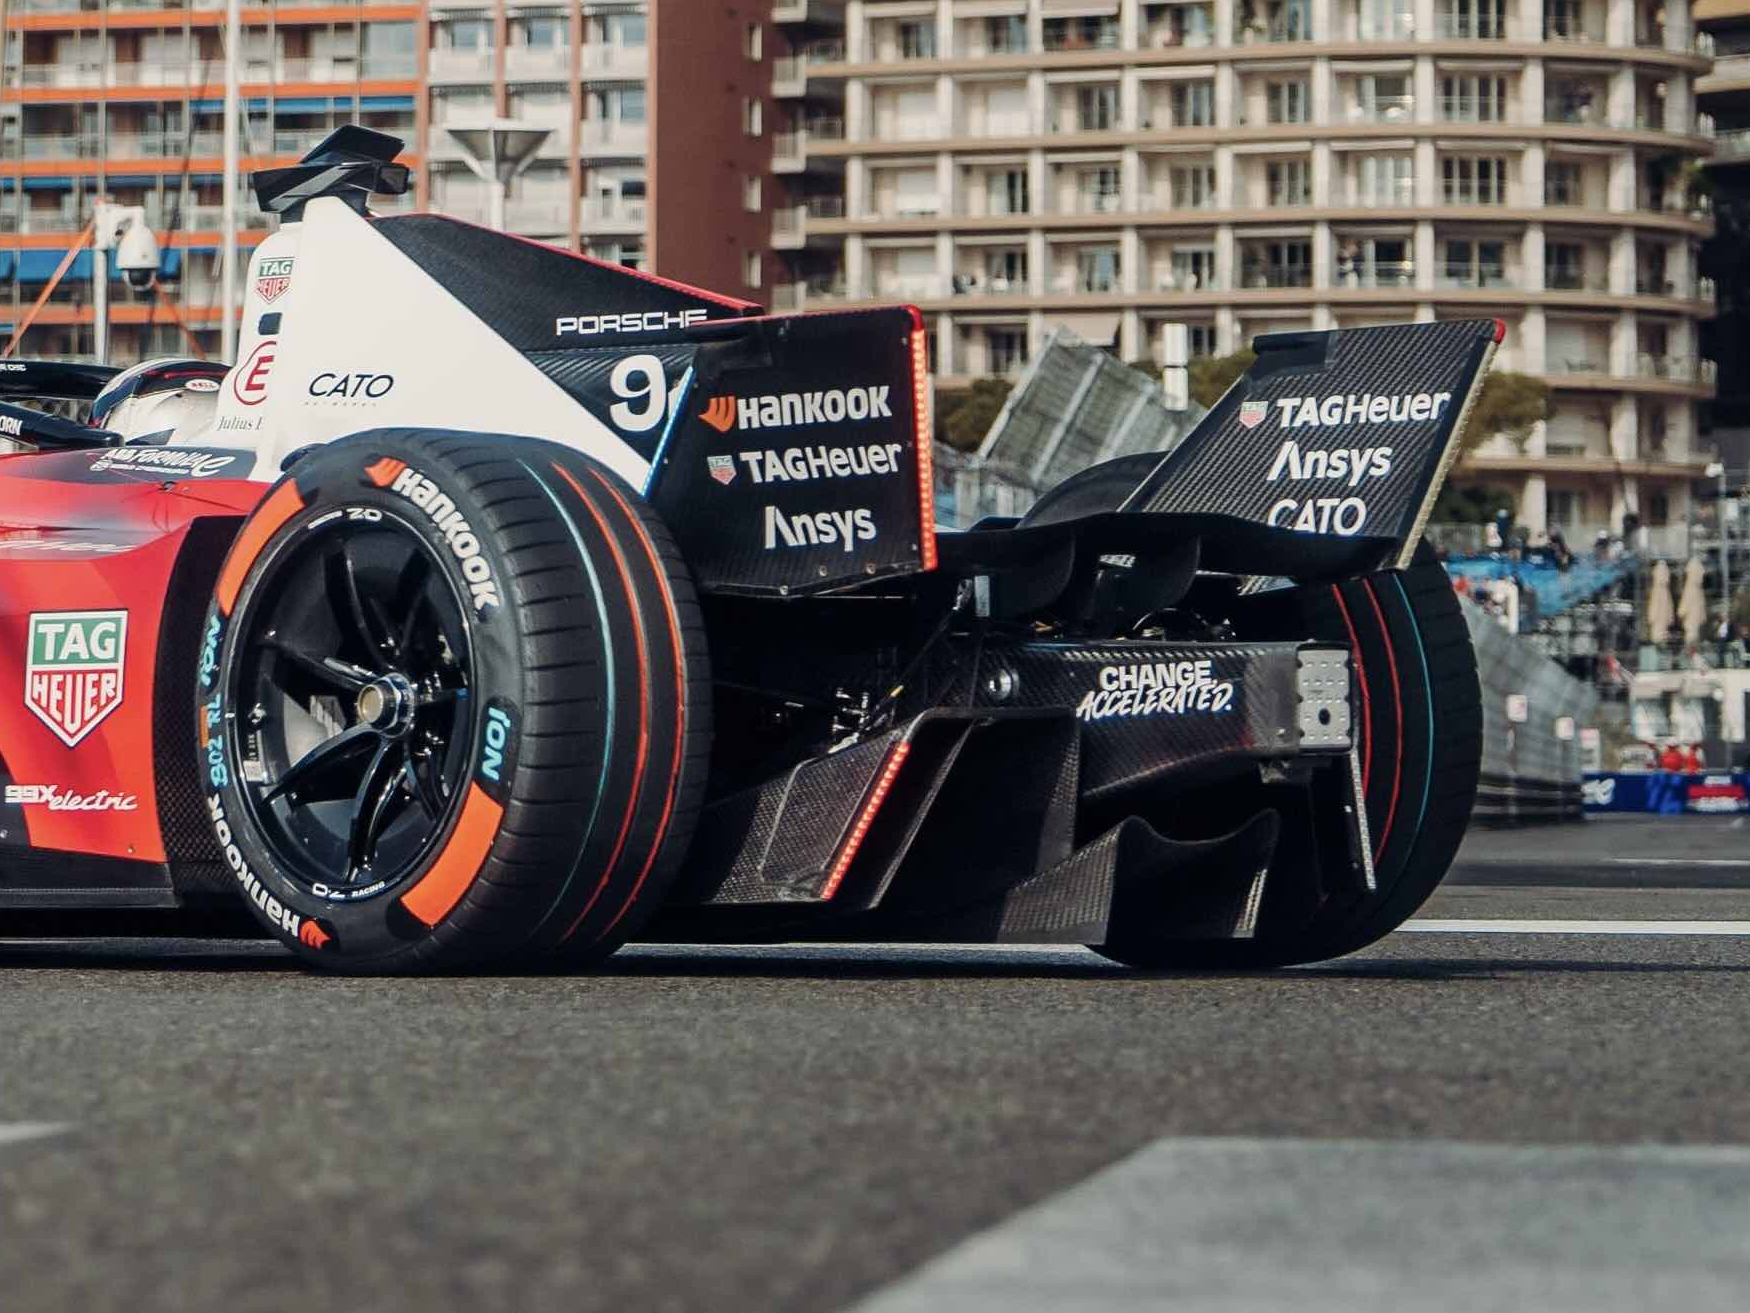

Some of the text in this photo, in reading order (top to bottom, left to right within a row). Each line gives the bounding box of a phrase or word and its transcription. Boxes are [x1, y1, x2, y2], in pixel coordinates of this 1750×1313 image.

[260, 260, 292, 276] TAG
[308, 373, 395, 399] CATO
[1267, 440, 1393, 486] Ansys
[764, 505, 877, 552] Ansys
[1267, 496, 1367, 535] CATO
[37, 622, 116, 662] TAG
[31, 673, 117, 731] HEUER
